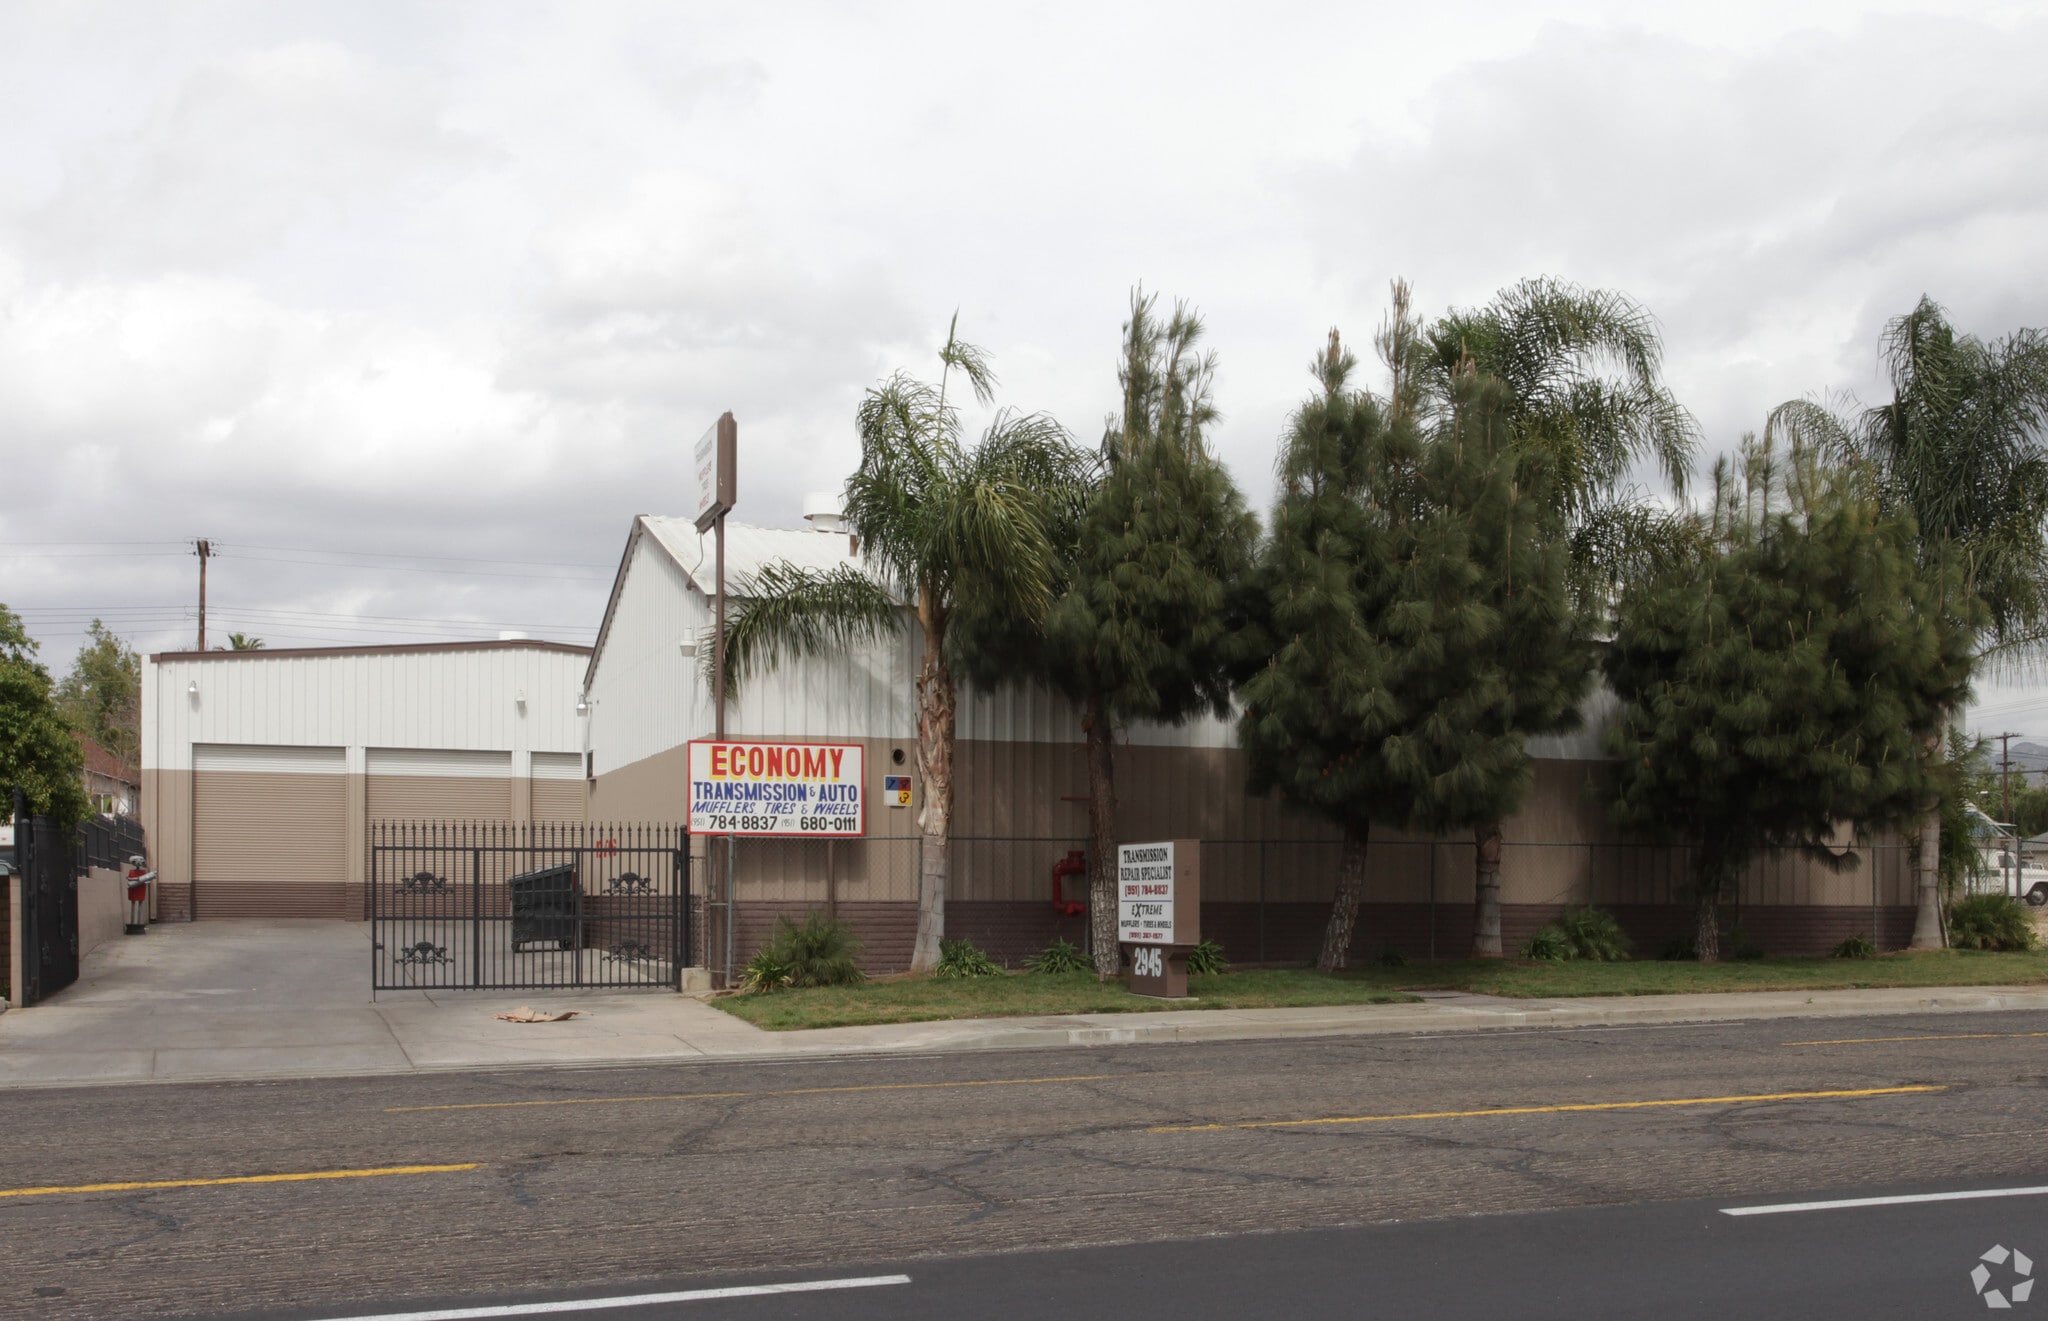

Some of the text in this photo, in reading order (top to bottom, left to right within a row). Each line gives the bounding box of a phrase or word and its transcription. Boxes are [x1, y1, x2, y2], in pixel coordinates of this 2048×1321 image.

[709, 745, 844, 782] ECONOMY
[693, 781, 858, 802] TRANSMISSION & AUTO
[691, 801, 859, 815] MUFFLERS TIRES & WHEELS
[709, 815, 778, 830] 784-8837
[800, 816, 856, 831] 680-0111
[1123, 848, 1168, 863] TRANSMISSION
[1120, 866, 1172, 881] REPAIR SPECIALIST
[1125, 885, 1168, 897] (951) 784-8837
[1121, 920, 1140, 928] MUFFLERS
[1143, 920, 1154, 928] TIRES
[1157, 920, 1171, 929] WHEELS
[1134, 947, 1162, 977] 2945
